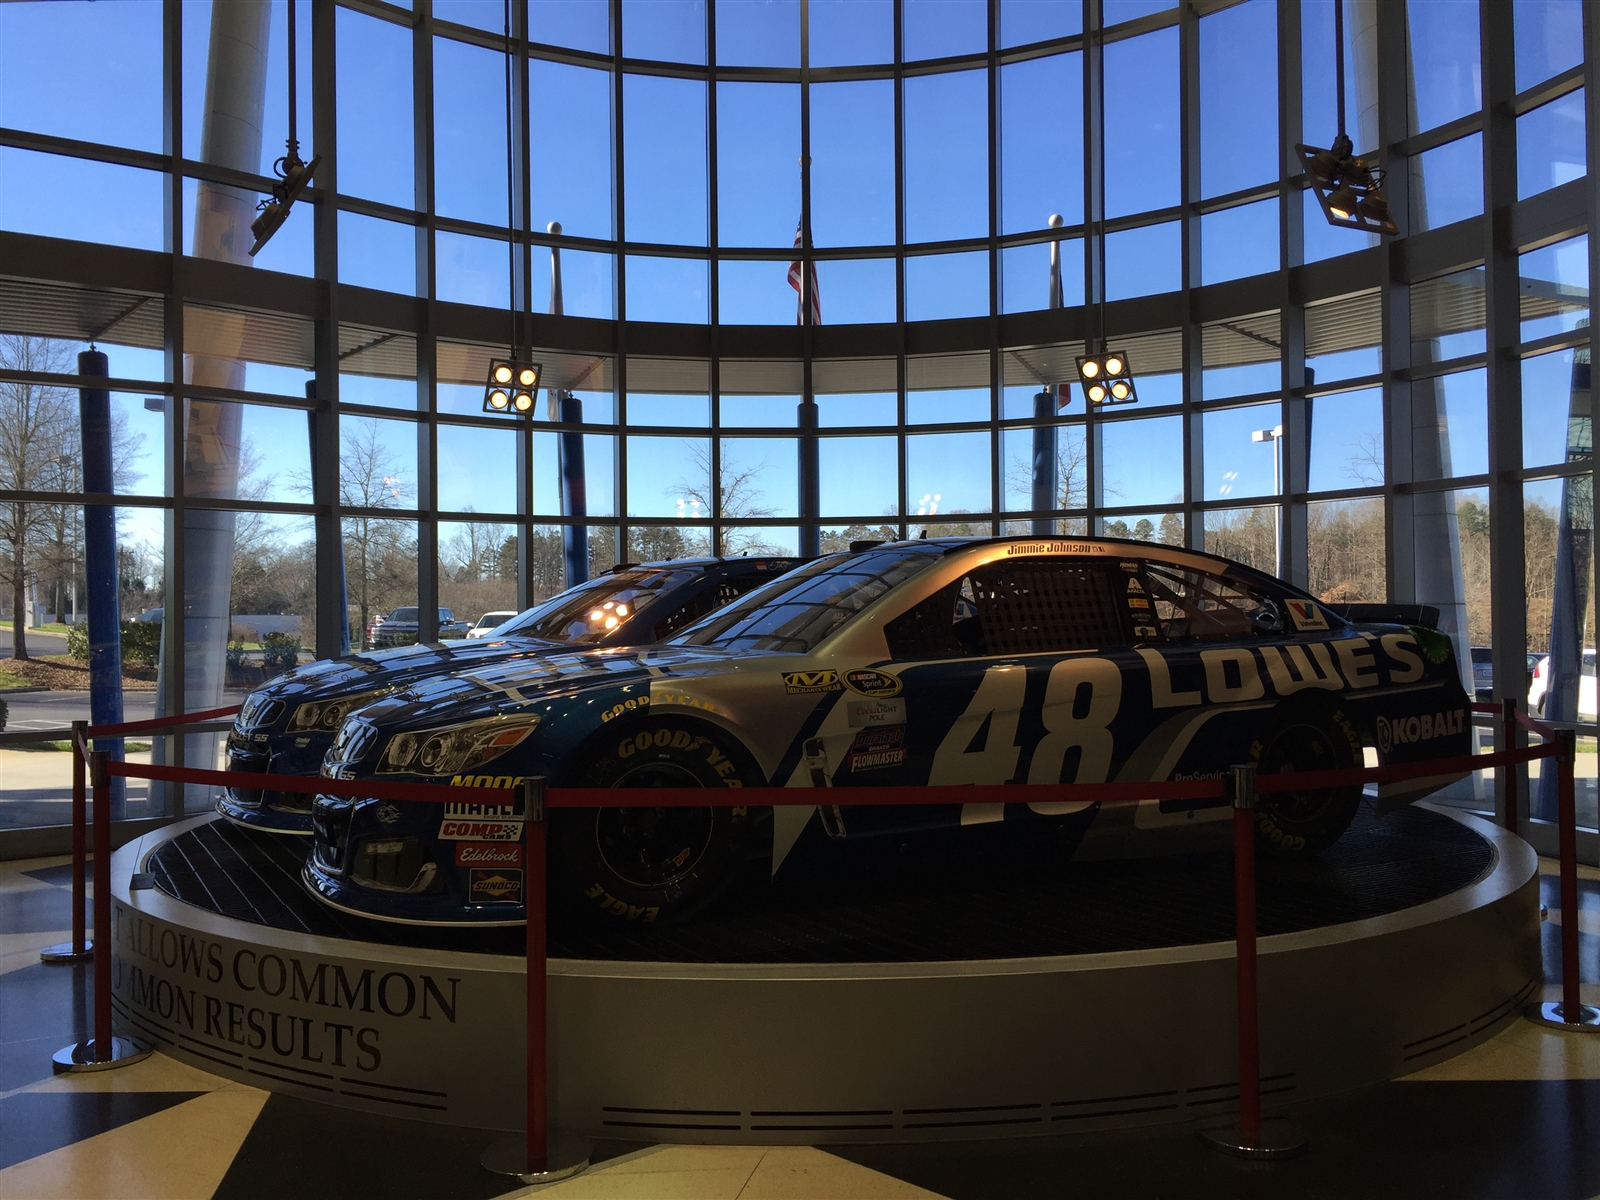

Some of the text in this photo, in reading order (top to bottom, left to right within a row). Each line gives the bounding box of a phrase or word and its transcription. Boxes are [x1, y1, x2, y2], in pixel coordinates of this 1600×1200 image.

[1007, 543, 1045, 555] Jimmie
[1046, 542, 1091, 553] Johnson
[1135, 632, 1425, 709] LOWE'S
[787, 683, 842, 694] MECHANIX WEAR
[861, 680, 882, 689] Sprint
[876, 706, 897, 714] LIGHT
[868, 714, 885, 722] POLE
[1392, 709, 1465, 746] KOBALT
[253, 734, 269, 742] SS
[857, 731, 900, 745] Duralast
[927, 657, 1123, 826] 48
[1332, 710, 1364, 764] EAGLE
[851, 750, 904, 773] FLOWMASTER
[1175, 769, 1231, 782] ProServic
[443, 822, 503, 837] COMP
[460, 847, 519, 862] Edelbrock
[472, 881, 521, 891] SUNOCO
[584, 882, 660, 922] EAGLE
[127, 917, 224, 983] ALLOWS
[233, 949, 461, 1024] COMMON
[204, 995, 382, 1072] RESULTS
